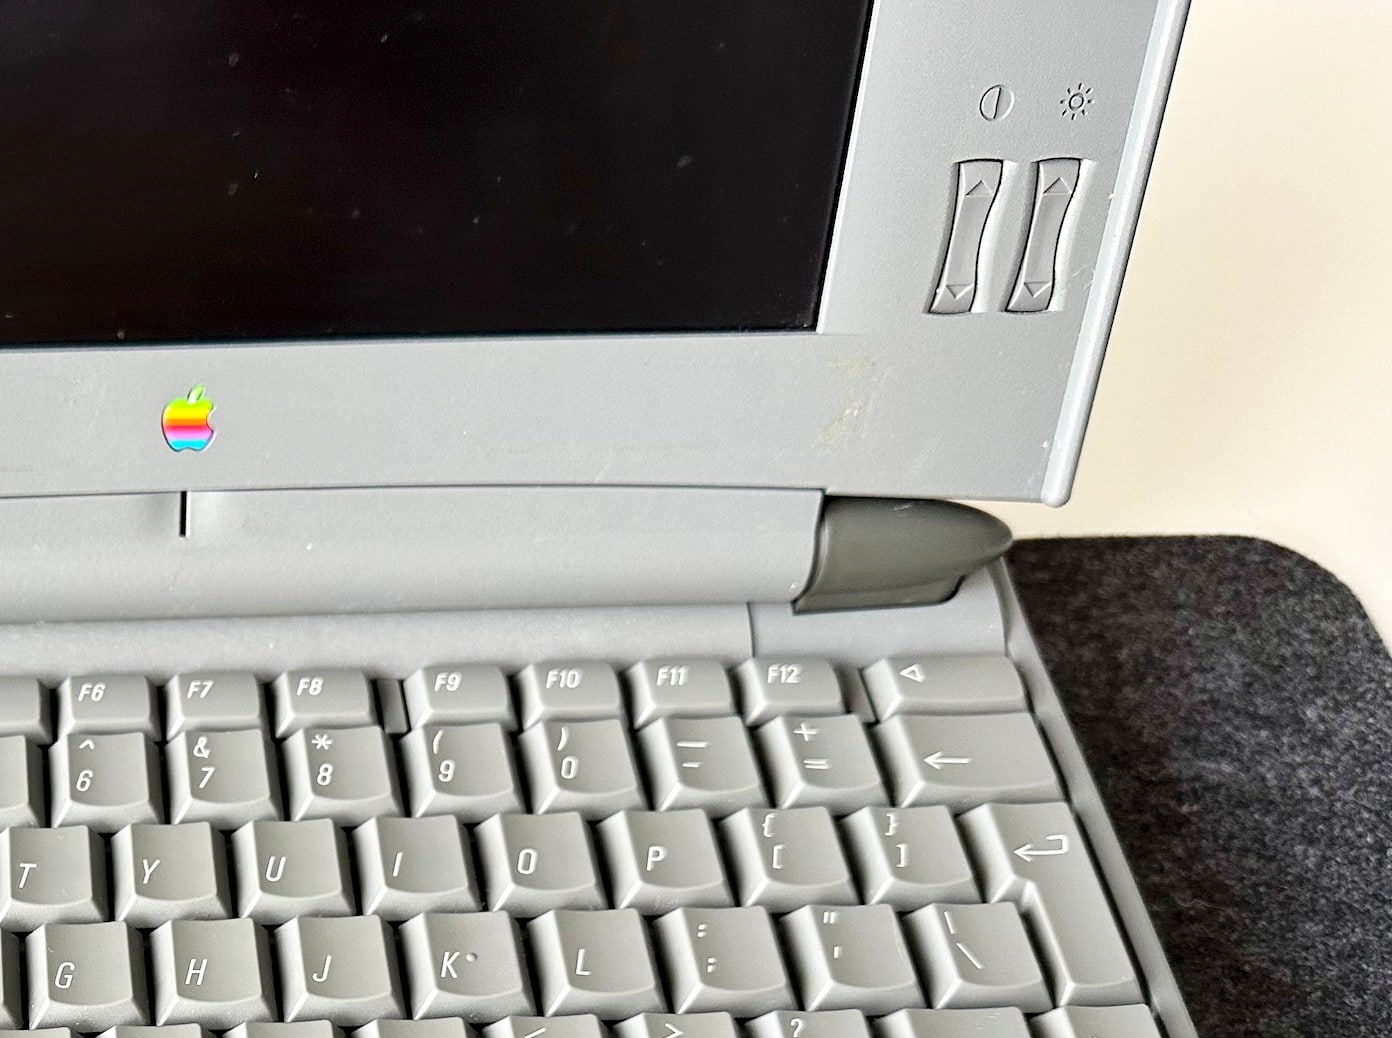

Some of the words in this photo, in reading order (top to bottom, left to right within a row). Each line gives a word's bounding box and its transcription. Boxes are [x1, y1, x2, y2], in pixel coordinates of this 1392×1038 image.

[435, 673, 461, 691] F9
[546, 669, 581, 688] F10
[657, 667, 686, 685] F11
[768, 664, 800, 683] F12
[78, 683, 105, 701] F6
[187, 680, 213, 698] F7
[297, 677, 323, 695] F8
[199, 767, 214, 788] 7
[317, 764, 332, 785] 8
[439, 760, 454, 782] 9
[561, 757, 576, 778] 0
[76, 770, 93, 791] 6
[266, 857, 285, 881] U
[518, 849, 536, 874] O
[647, 846, 664, 871] P
[19, 863, 37, 888] T
[143, 860, 160, 884] Y
[186, 959, 207, 985] H
[312, 956, 331, 982] J
[441, 952, 459, 978] K
[576, 949, 590, 975] L
[55, 962, 74, 988] G
